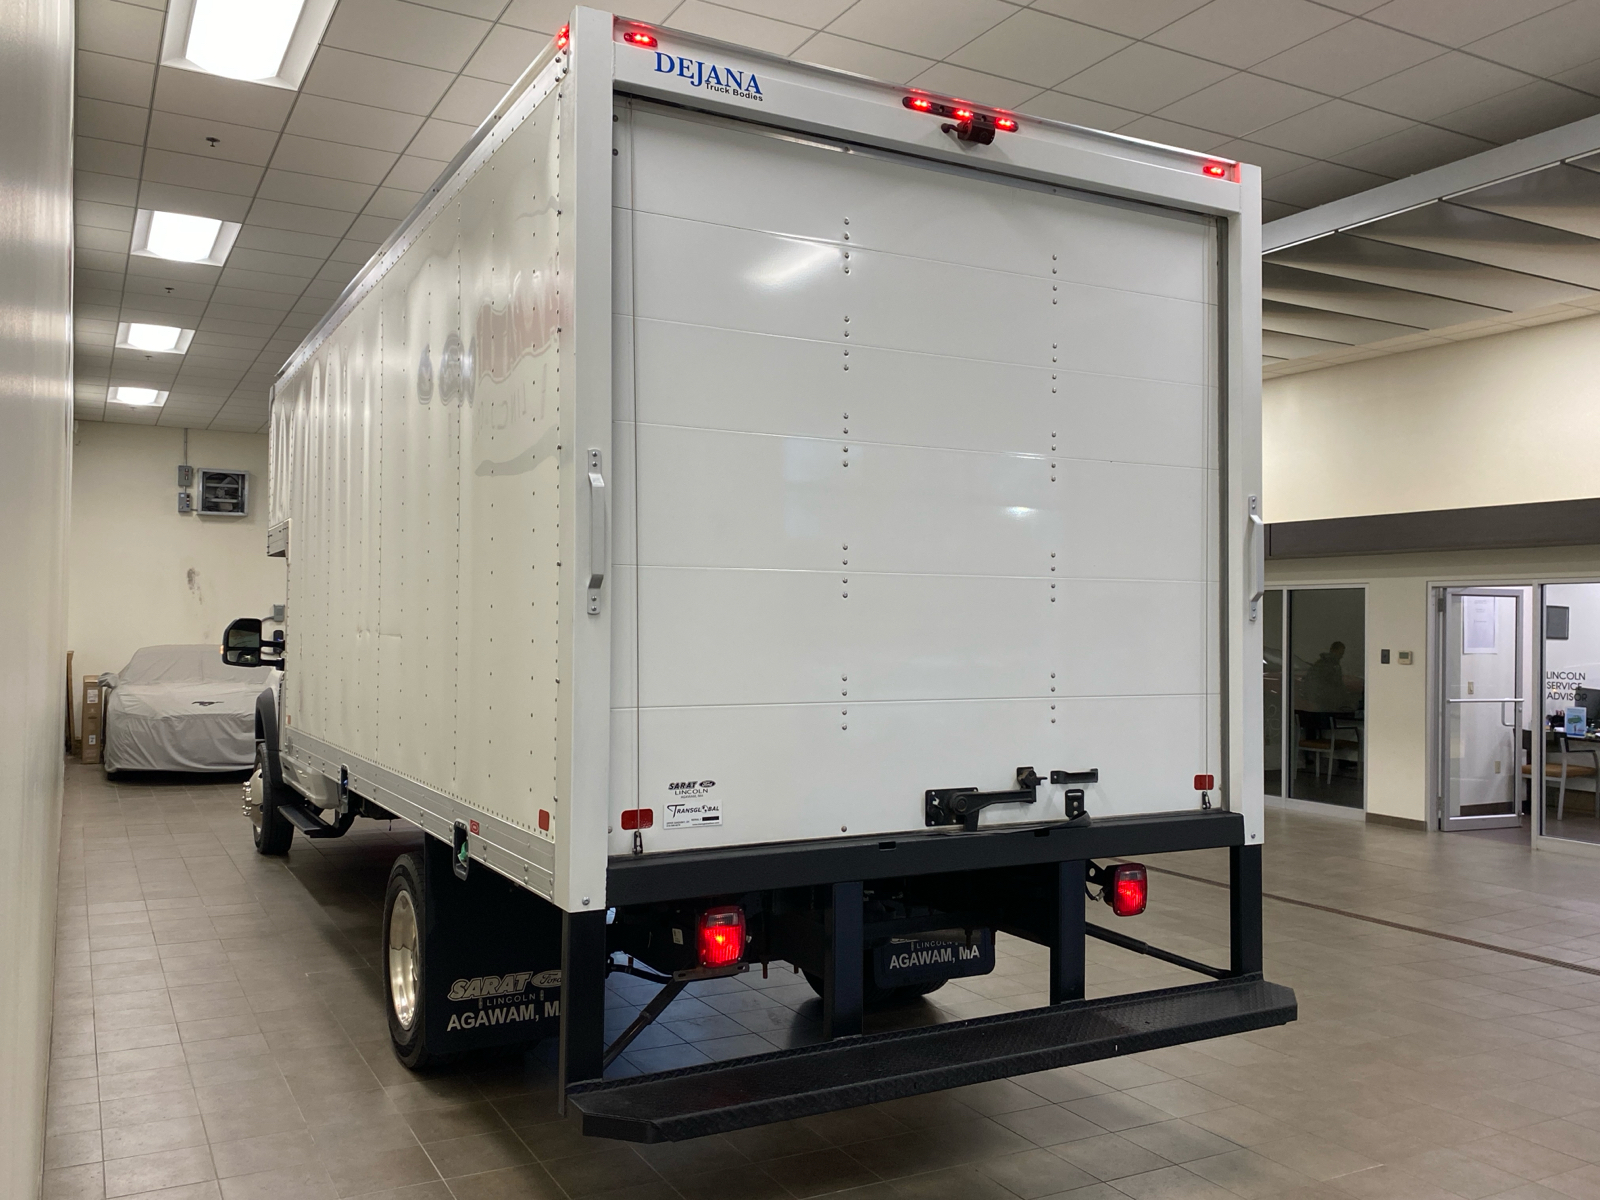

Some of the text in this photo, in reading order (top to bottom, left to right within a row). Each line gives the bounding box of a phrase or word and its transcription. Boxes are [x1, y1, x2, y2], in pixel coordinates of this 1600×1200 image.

[654, 51, 763, 95] DEJANA
[704, 82, 763, 102] Truck Bodies
[1546, 671, 1586, 681] LINCOLN
[1546, 681, 1583, 691] SERVICE
[1546, 691, 1588, 702] ADVISOR
[668, 781, 698, 790] SARAT
[889, 944, 980, 970] AGAWAM, MA
[448, 971, 533, 1001] SARAT
[486, 993, 536, 1006] LINCOLN
[446, 1000, 561, 1032] AGAWAM, M
